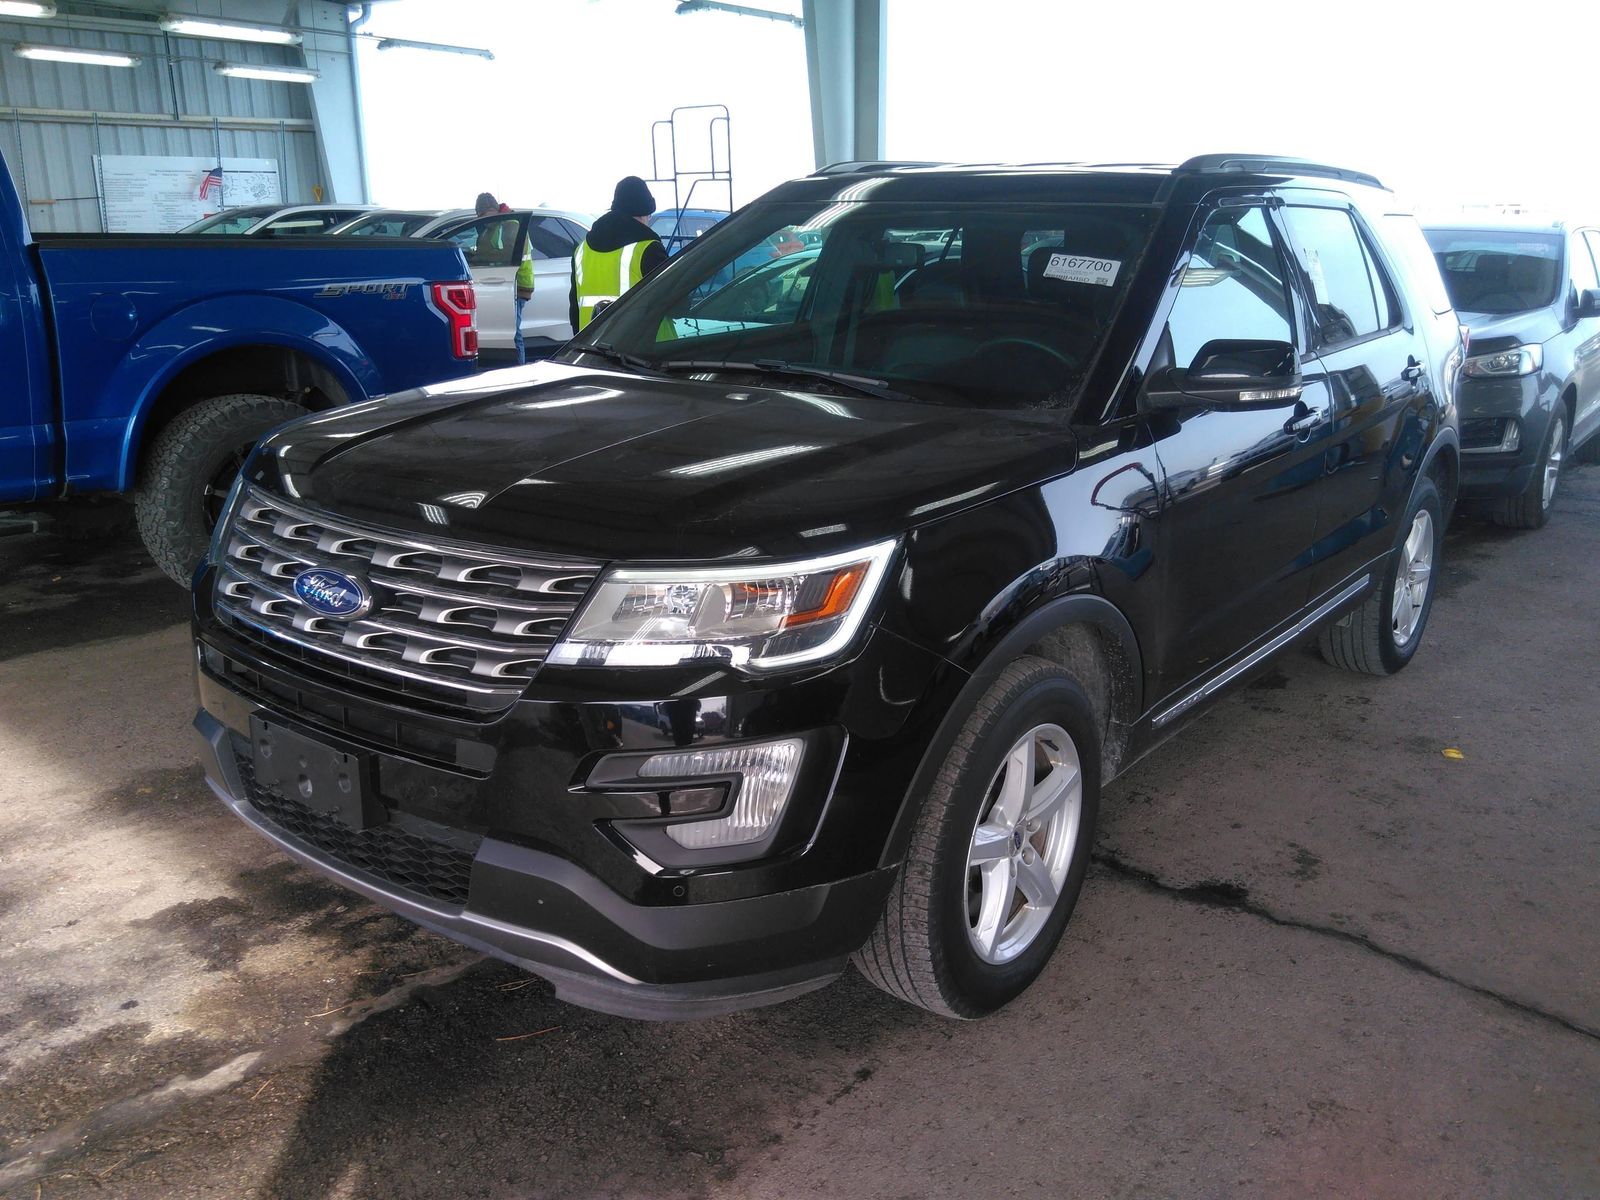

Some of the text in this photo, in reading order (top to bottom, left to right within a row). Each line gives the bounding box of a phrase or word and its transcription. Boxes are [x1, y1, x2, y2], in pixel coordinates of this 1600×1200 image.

[1050, 256, 1113, 273] 6167700
[313, 281, 418, 298] SPORT
[303, 574, 345, 607] Ford
